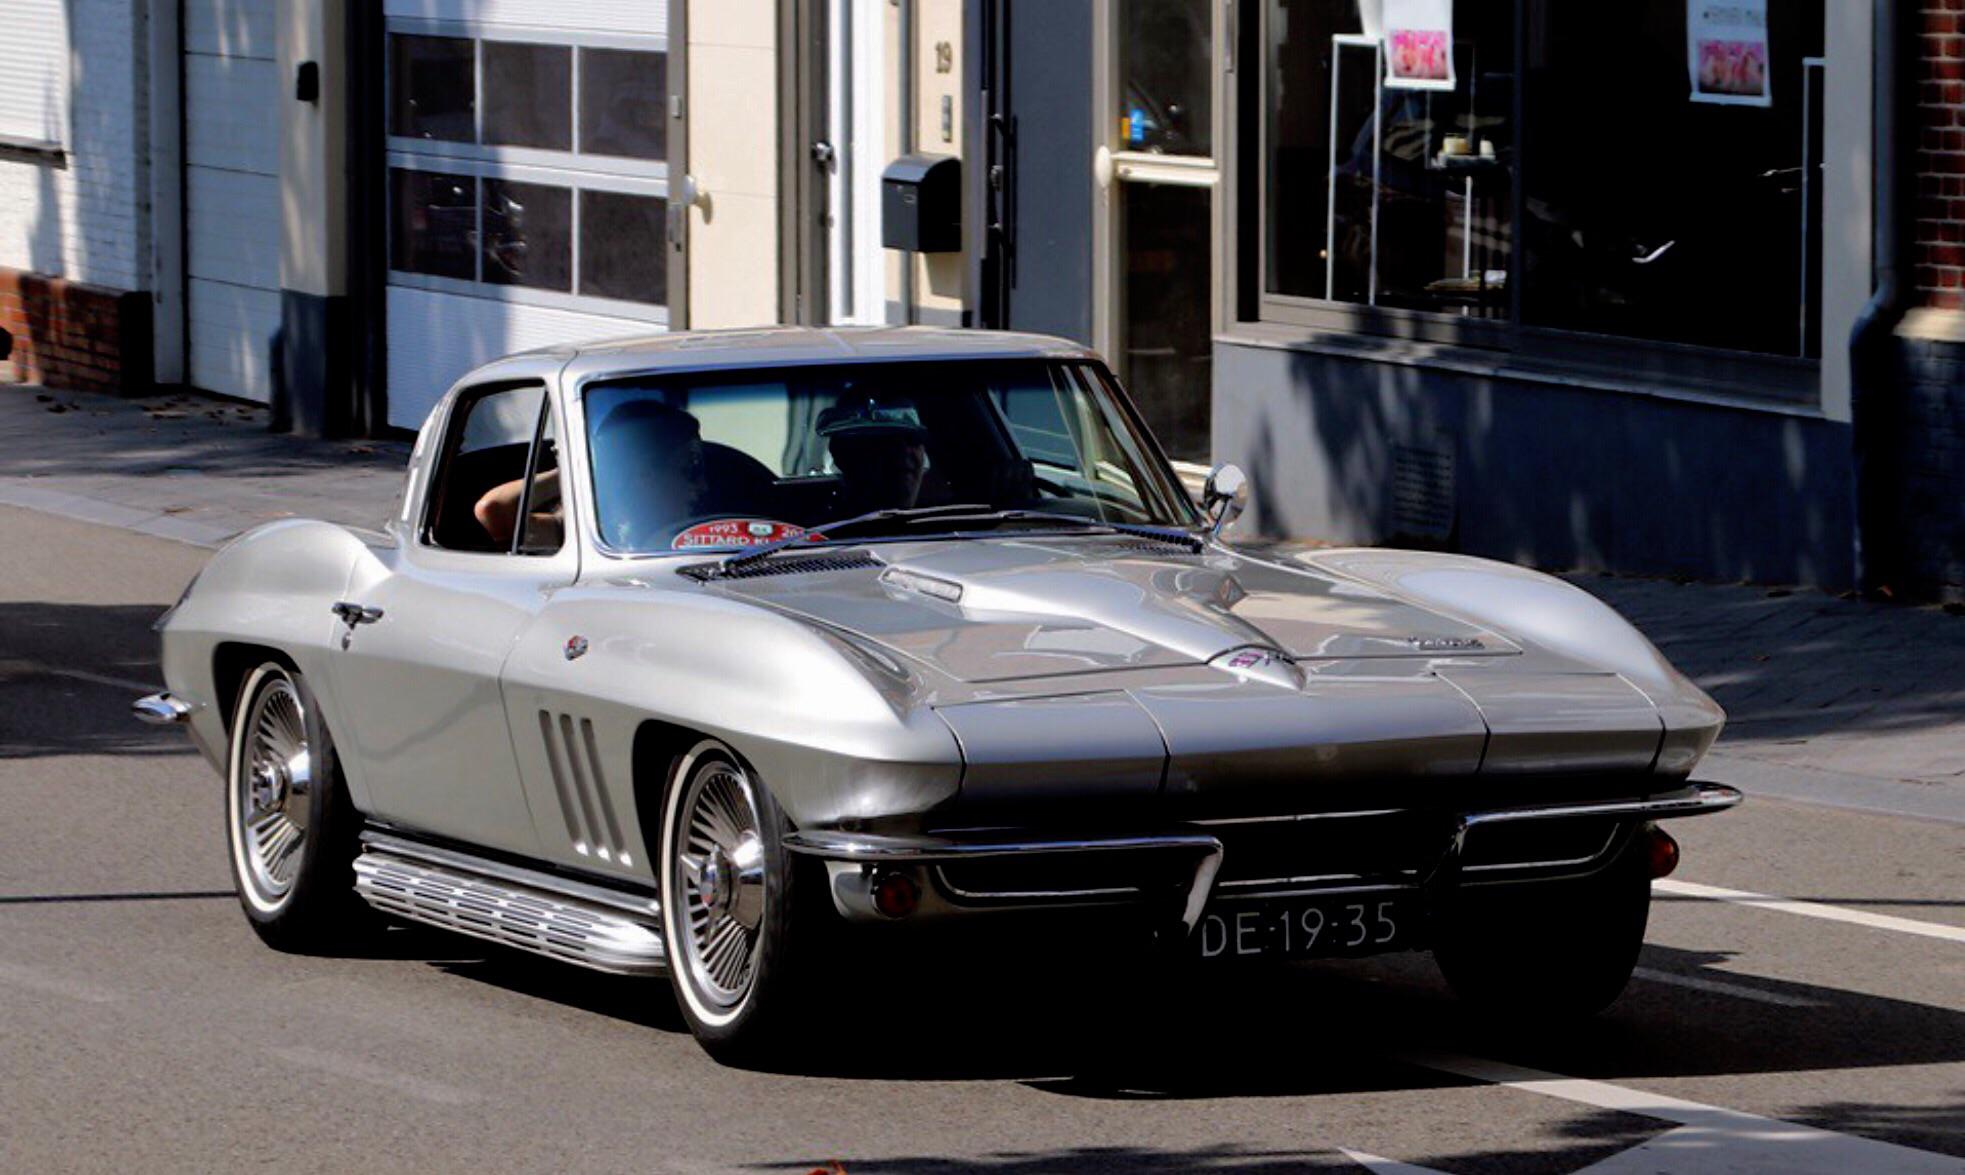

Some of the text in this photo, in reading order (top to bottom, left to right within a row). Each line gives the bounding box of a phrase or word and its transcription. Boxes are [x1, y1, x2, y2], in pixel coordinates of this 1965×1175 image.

[935, 41, 952, 74] 19
[683, 532, 750, 546] SITTARD
[708, 522, 739, 534] 1993
[1202, 902, 1396, 957] DE-19-35
